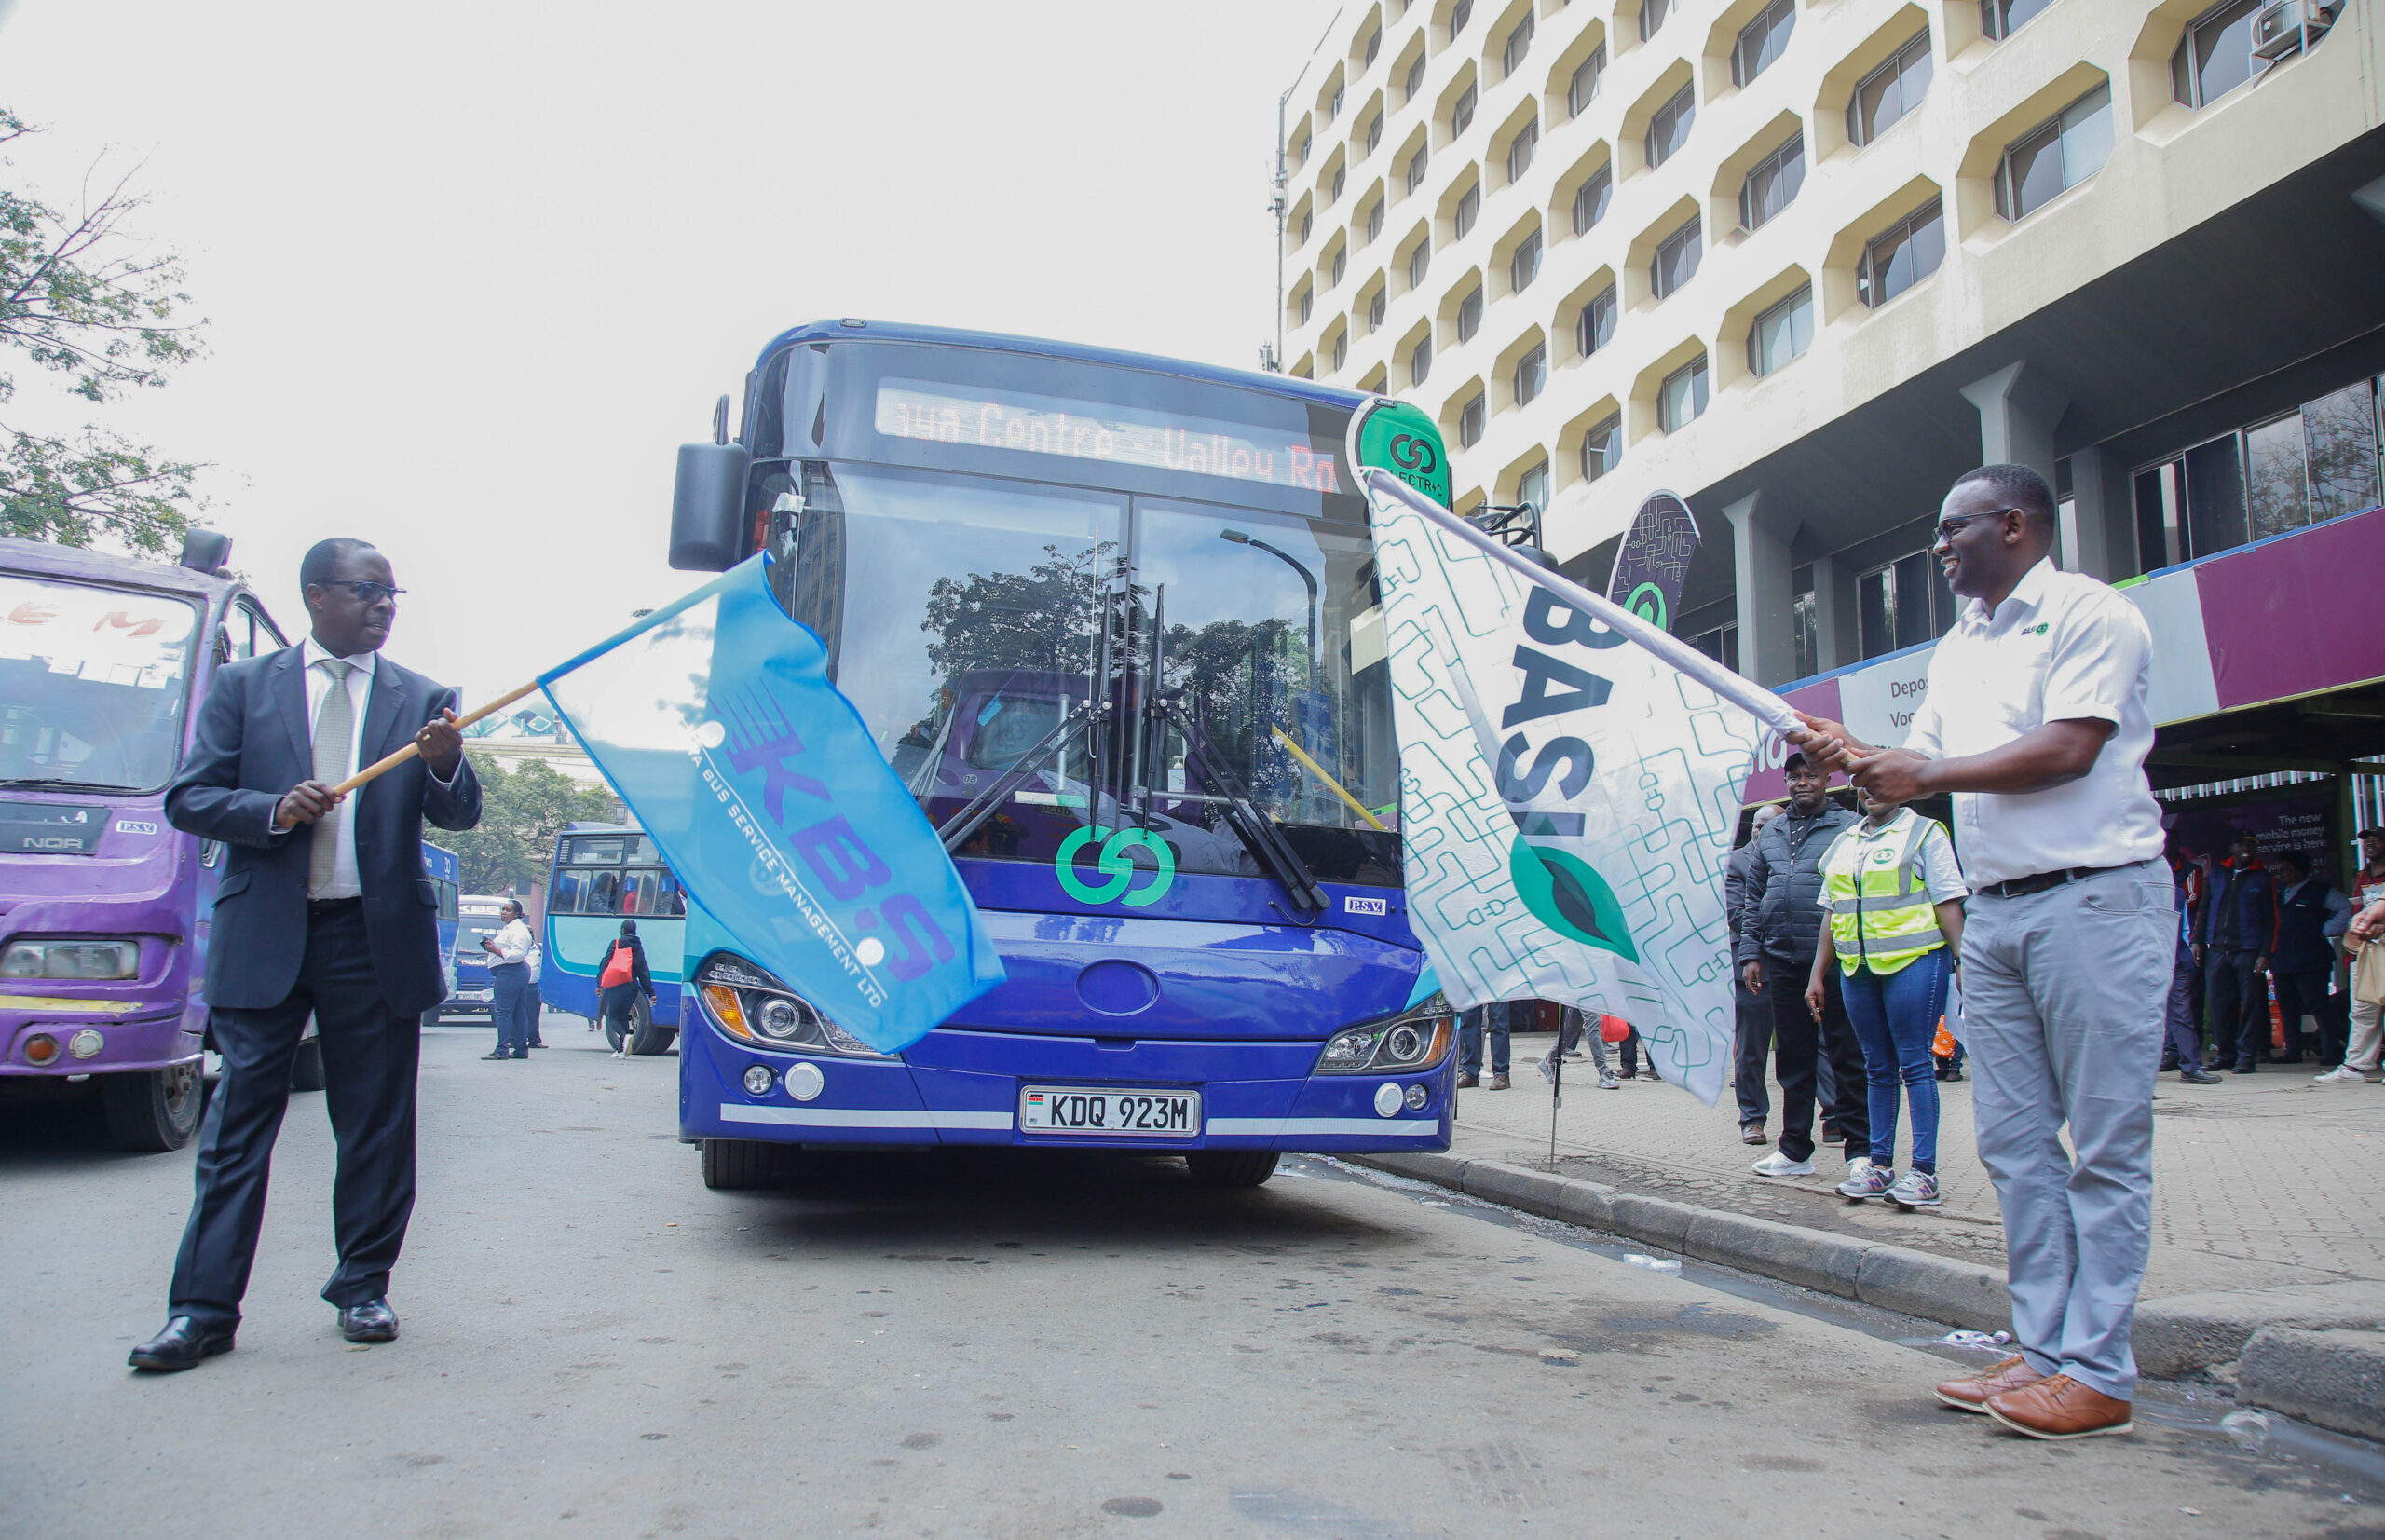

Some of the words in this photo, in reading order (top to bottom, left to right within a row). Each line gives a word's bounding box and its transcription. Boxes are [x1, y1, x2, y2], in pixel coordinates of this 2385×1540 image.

[980, 402, 1113, 460] Centre
[2278, 815, 2297, 825] The
[2298, 813, 2322, 823] new
[2256, 827, 2290, 840] mobile
[2291, 825, 2325, 838] money
[23, 838, 83, 849] NQR
[702, 758, 730, 803] BUS
[727, 804, 779, 872] SERVICE
[776, 872, 861, 976] MANAGEMENT
[857, 977, 882, 1008] LTD
[1351, 900, 1382, 913] P.S.V.
[1051, 1095, 1106, 1127] KDQ
[1119, 1097, 1188, 1130] 923M
